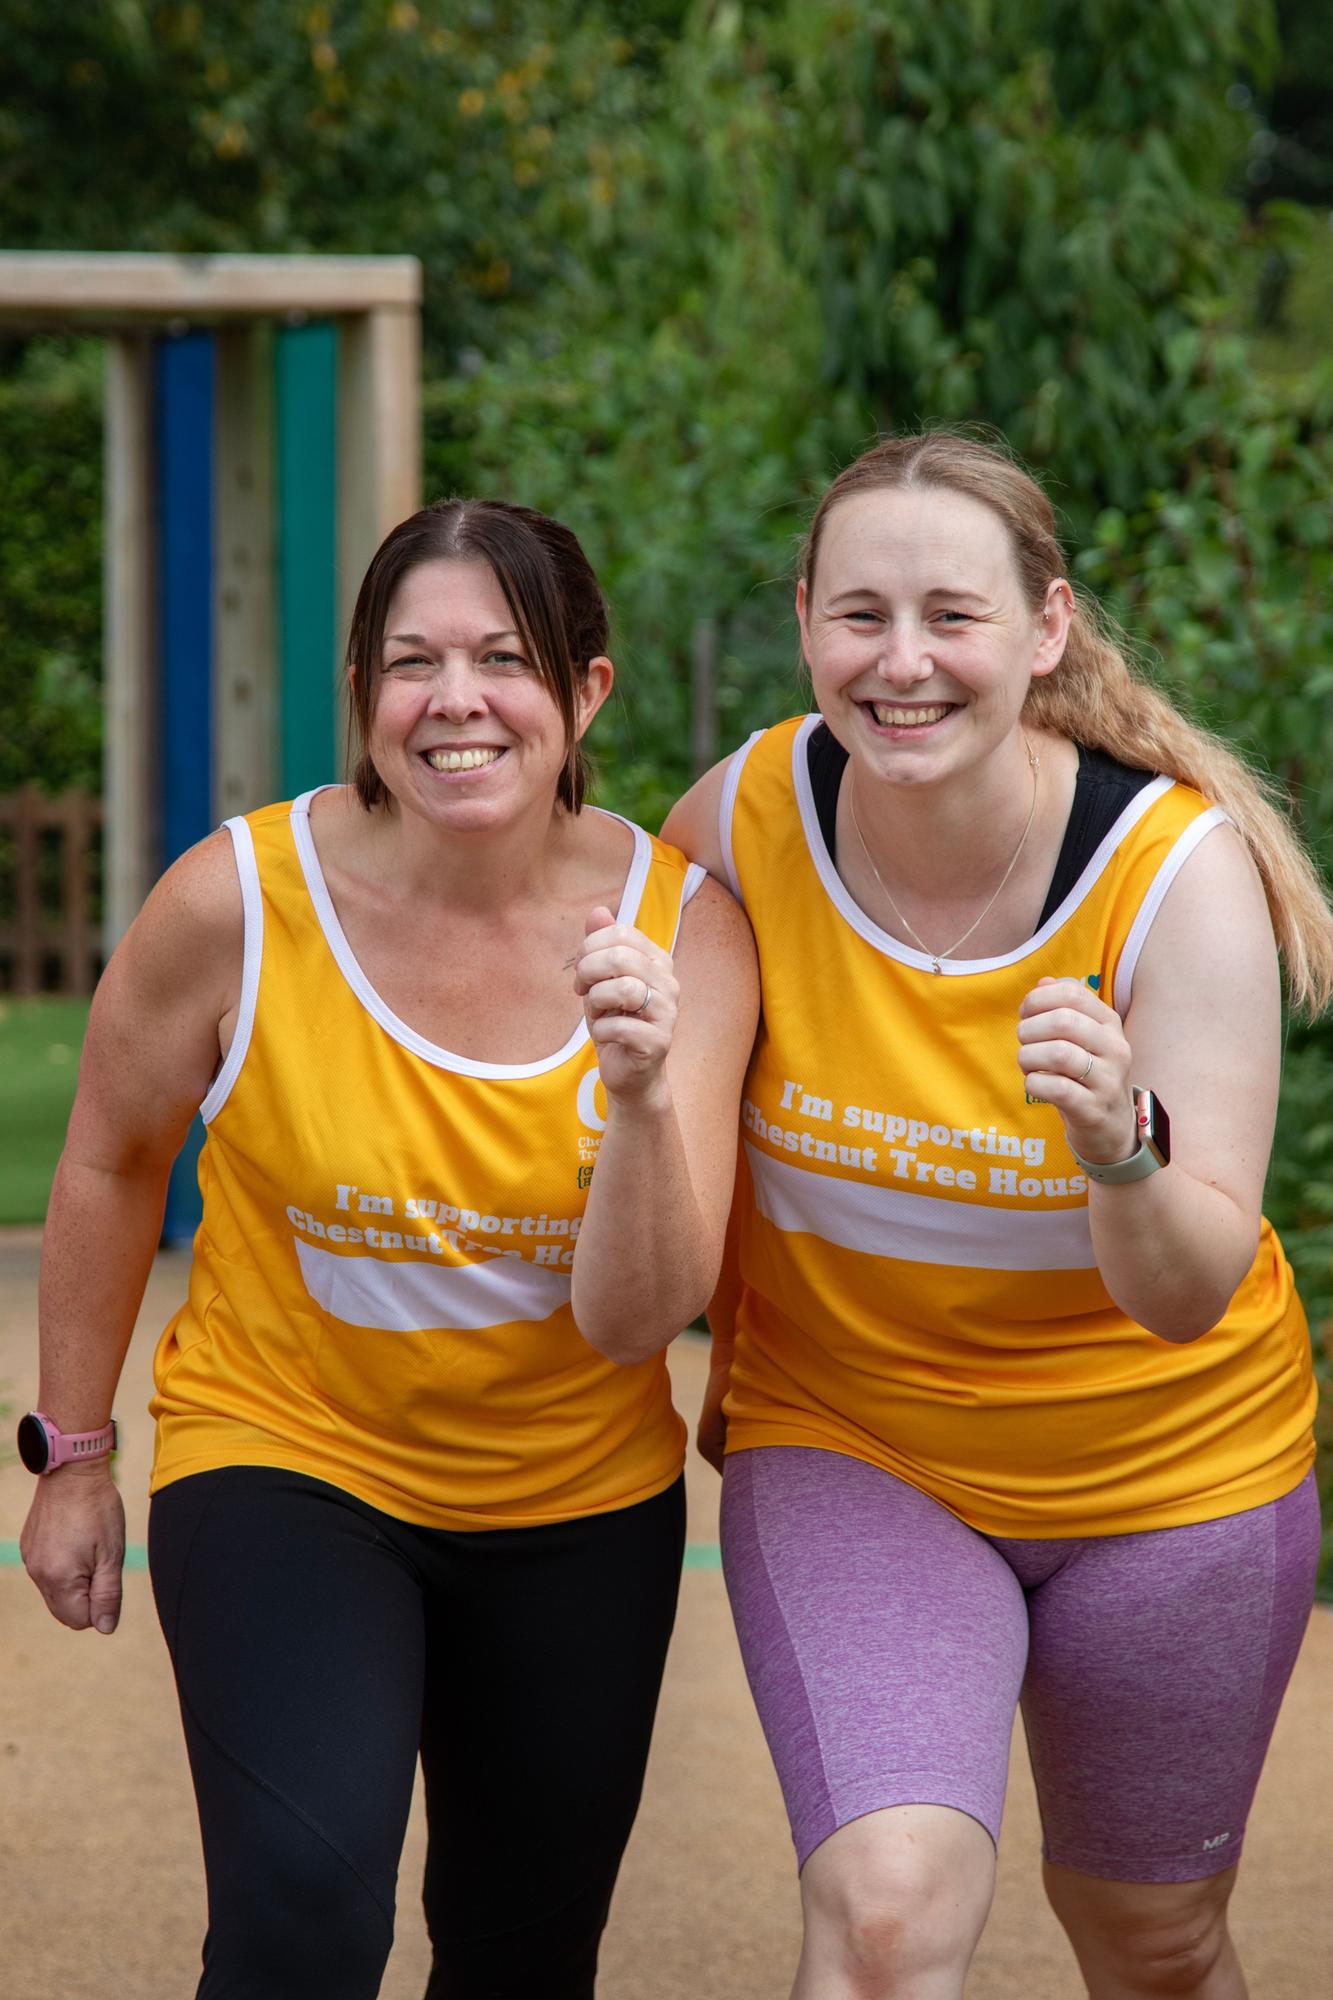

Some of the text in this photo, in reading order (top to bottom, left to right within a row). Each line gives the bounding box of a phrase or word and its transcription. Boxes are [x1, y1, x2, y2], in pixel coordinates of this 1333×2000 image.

[742, 1099, 1088, 1198] Chestnut Tree Hous
[780, 1079, 1046, 1166] I'm supporting
[286, 1205, 444, 1255] Chestnut
[336, 1184, 394, 1216] I'm
